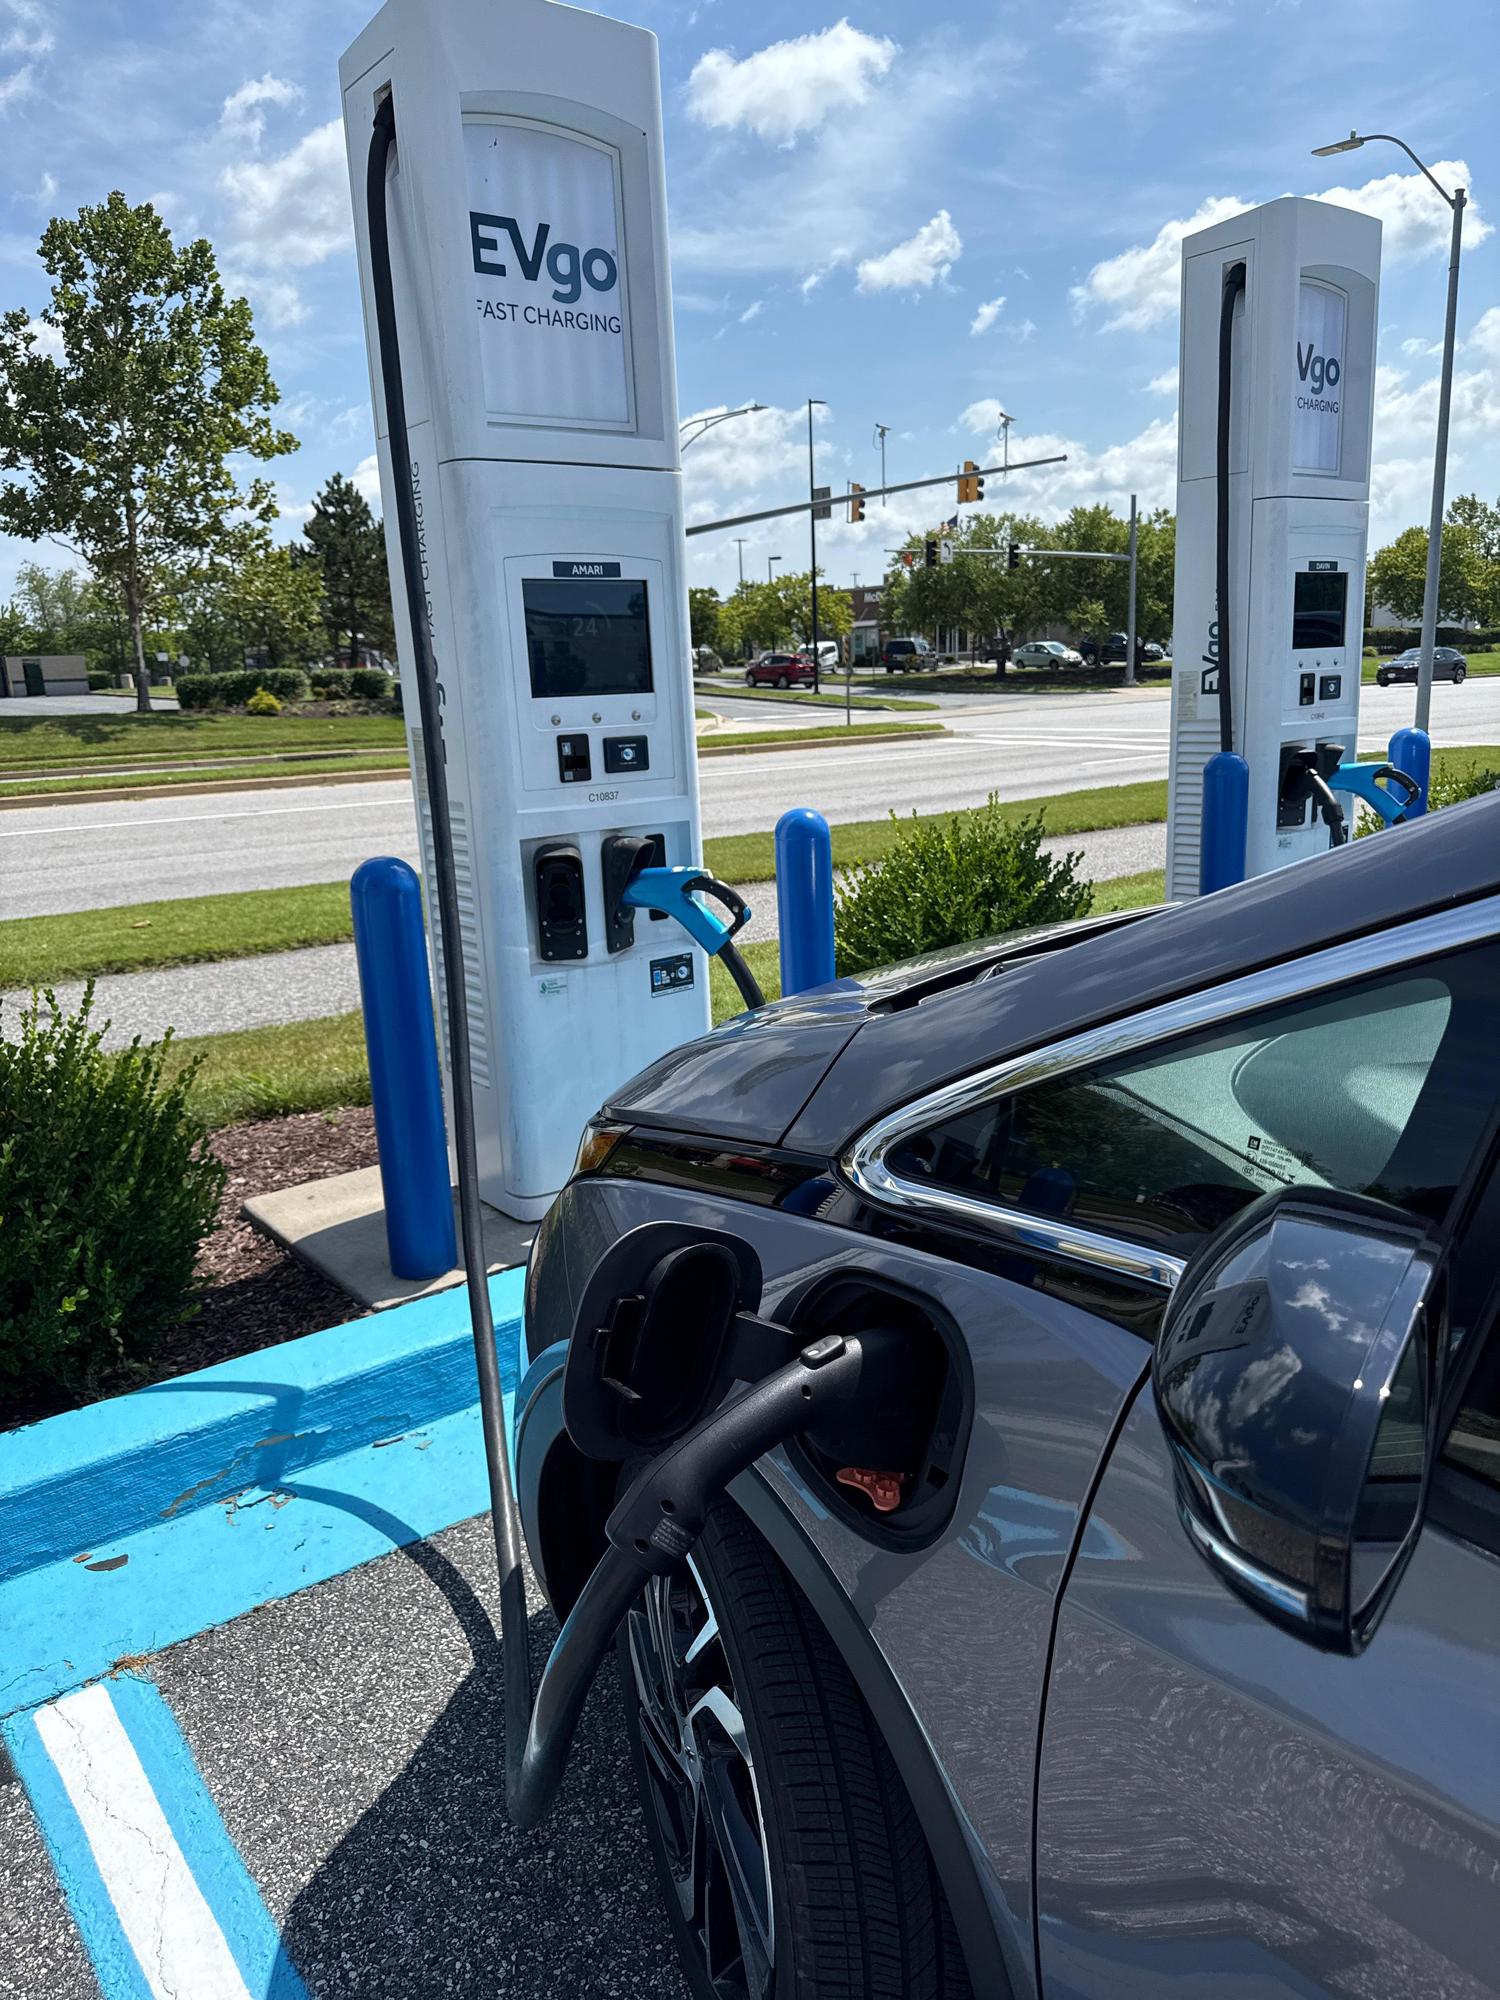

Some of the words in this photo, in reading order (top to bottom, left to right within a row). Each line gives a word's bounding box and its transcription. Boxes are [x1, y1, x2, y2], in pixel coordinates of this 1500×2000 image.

[469, 211, 618, 304] EVgo
[523, 305, 622, 334] CHARGING
[1297, 341, 1340, 395] Vgo
[1297, 397, 1339, 414] CHARGING
[571, 564, 604, 576] AMARI
[572, 617, 598, 637] 24
[588, 791, 620, 802] C10837
